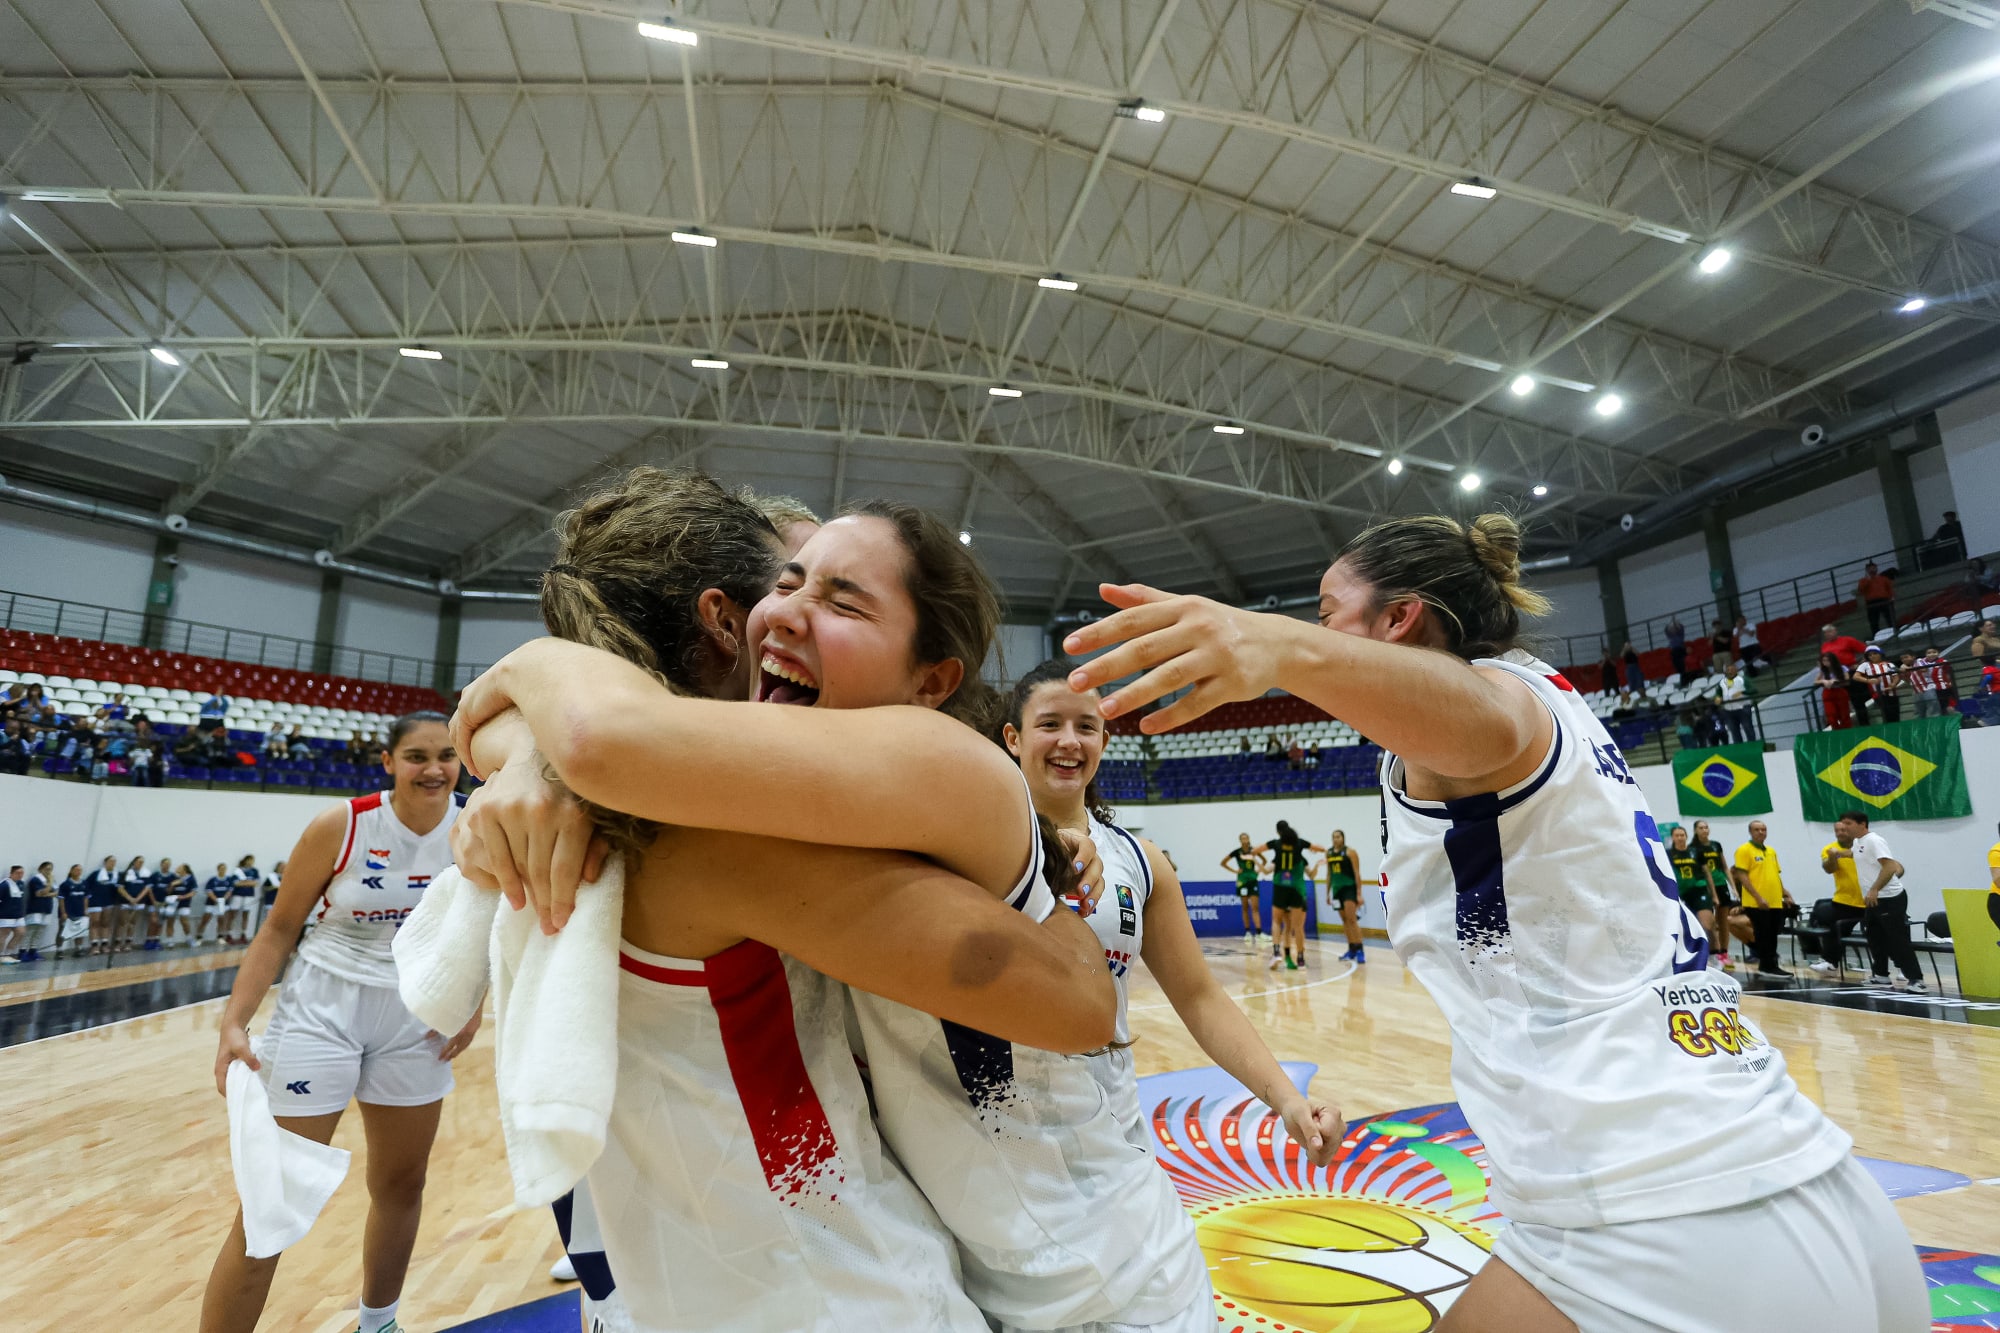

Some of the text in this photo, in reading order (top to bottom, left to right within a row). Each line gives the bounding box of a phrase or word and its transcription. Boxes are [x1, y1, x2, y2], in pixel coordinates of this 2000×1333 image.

[1281, 851, 1294, 870] 11
[1122, 911, 1135, 923] FIBA
[1652, 984, 1715, 1007] Yerba
